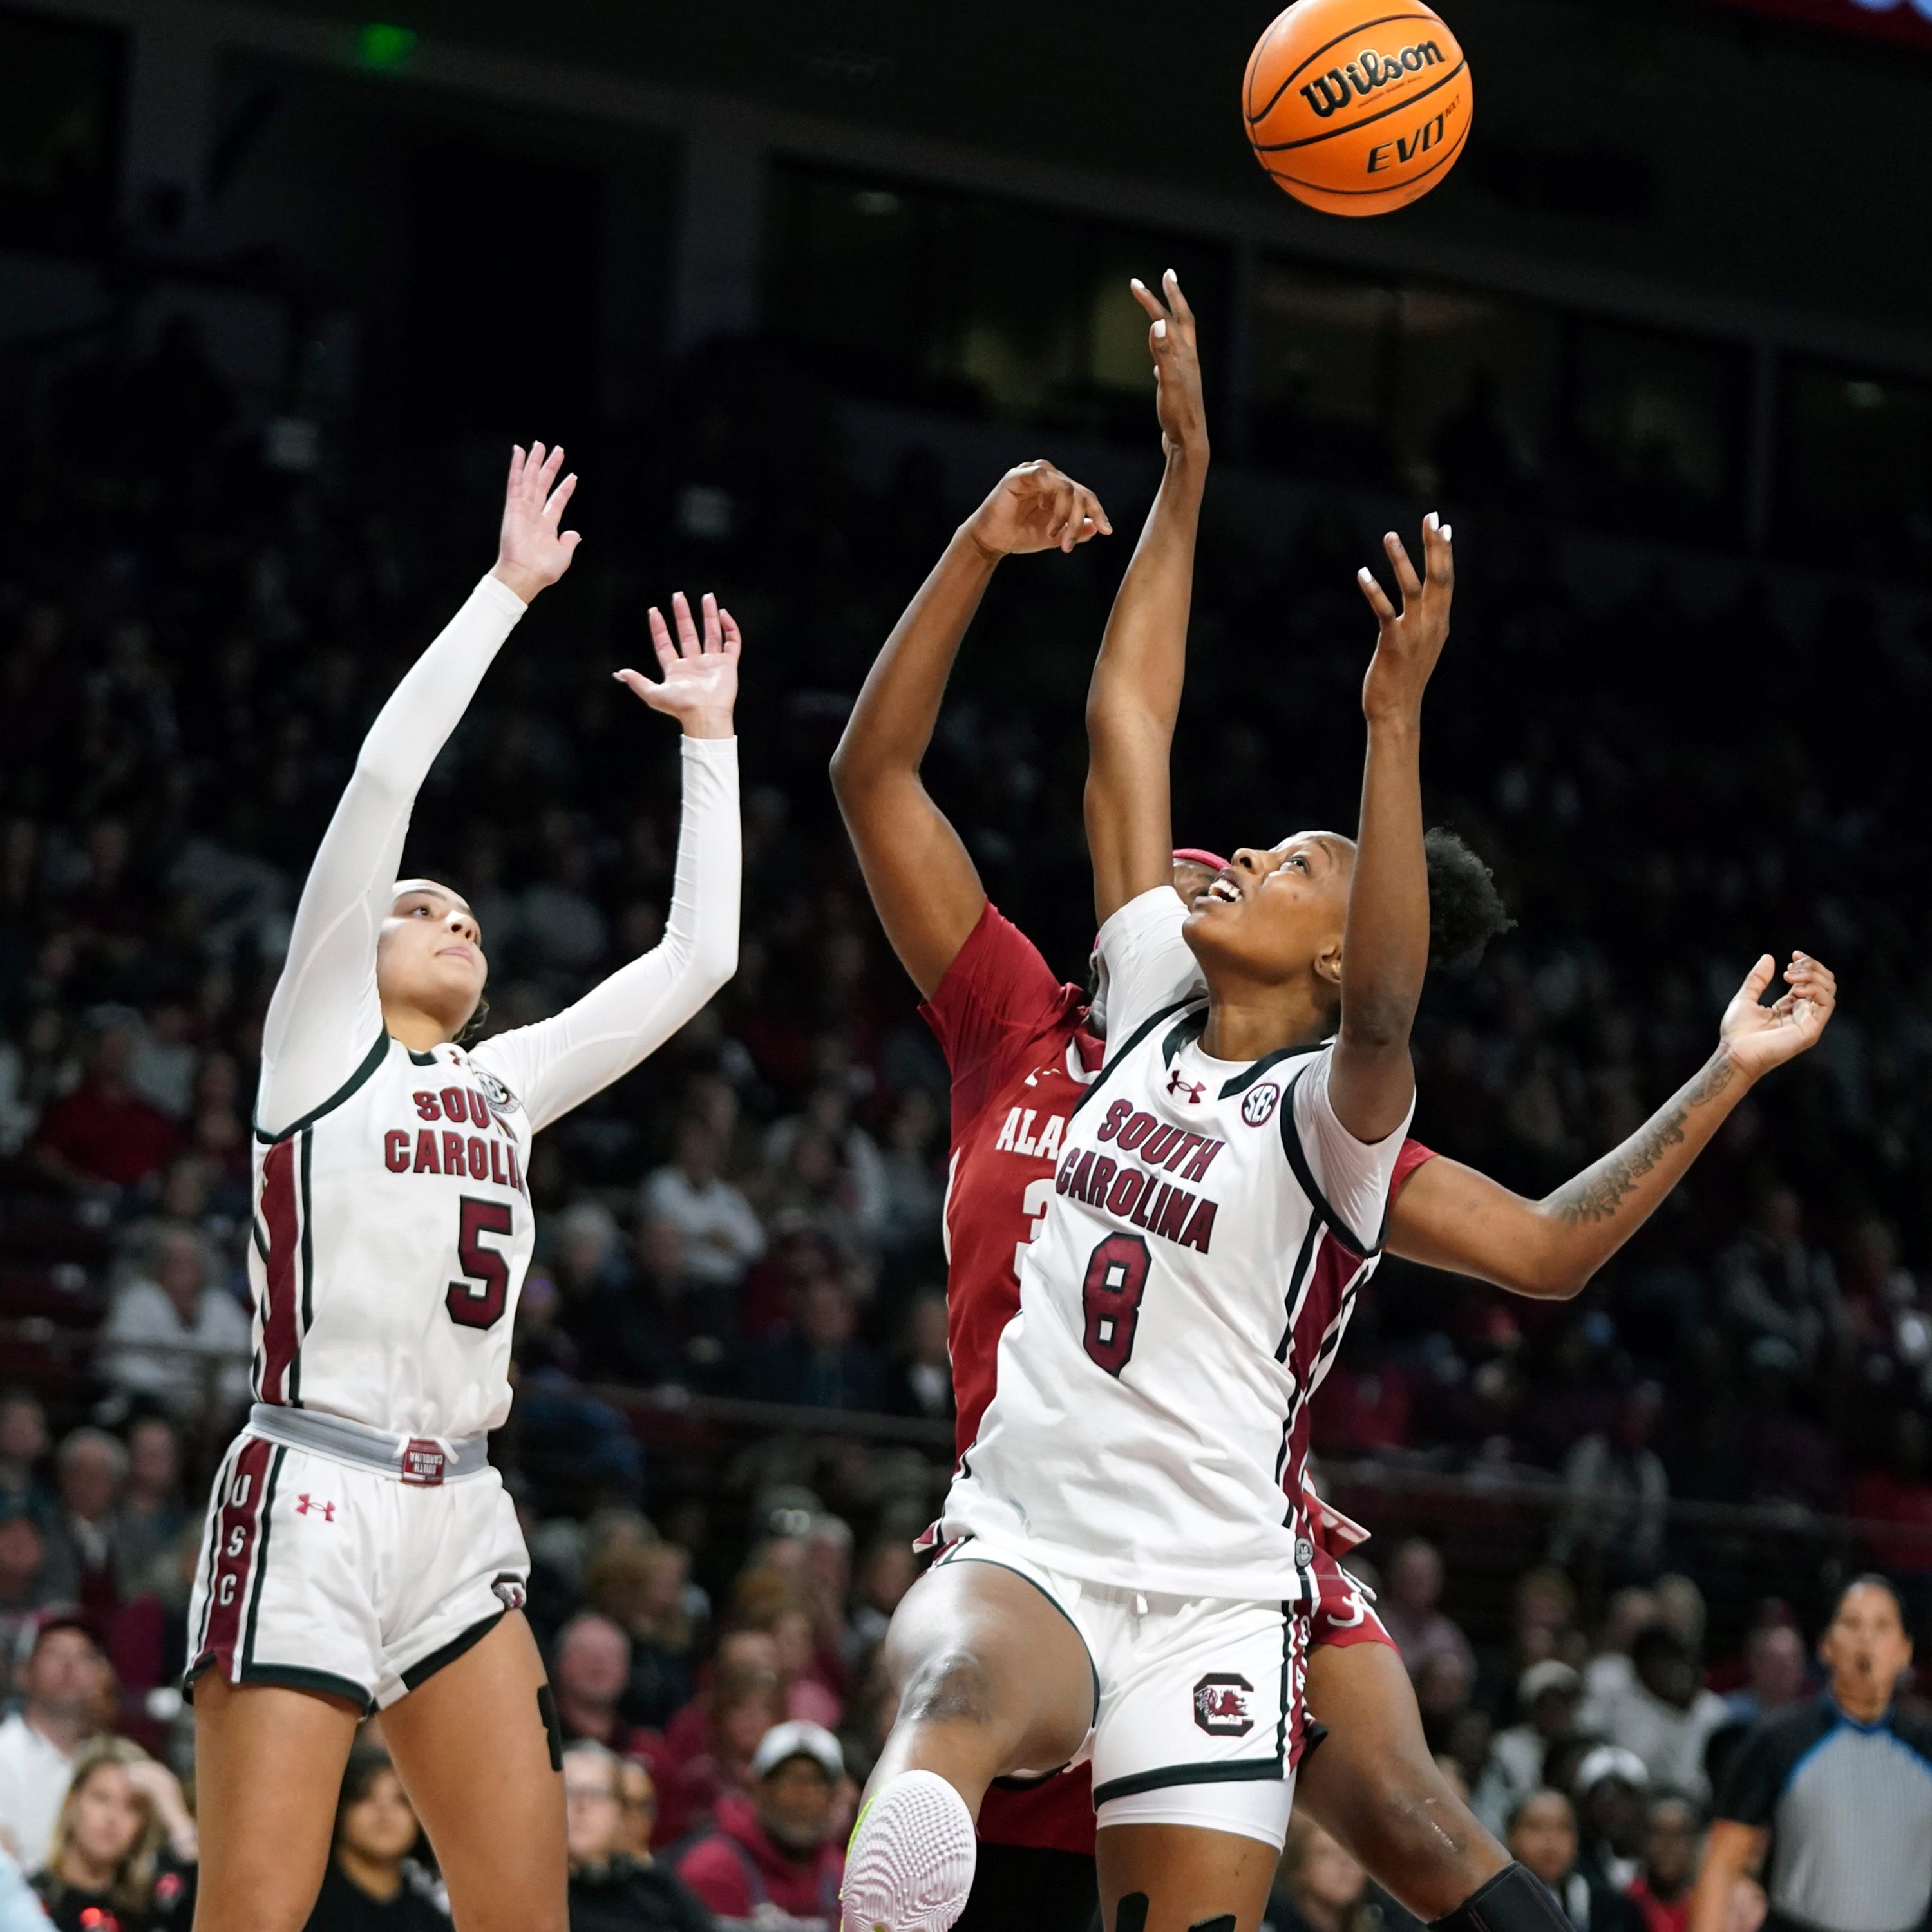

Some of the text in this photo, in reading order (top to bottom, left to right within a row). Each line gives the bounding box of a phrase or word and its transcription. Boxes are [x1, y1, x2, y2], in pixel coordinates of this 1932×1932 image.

[1300, 40, 1446, 117] Wilson
[1367, 112, 1445, 173] EVO
[413, 1086, 515, 1140] SOU
[996, 1106, 1066, 1160] ALA
[1243, 1084, 1278, 1124] SEC
[384, 1128, 529, 1200] CAROLI
[1097, 1098, 1225, 1183] SOUTH
[1056, 1148, 1218, 1255] CAROLINA
[445, 1195, 513, 1331] 5
[1082, 1231, 1152, 1378] 8
[410, 1451, 443, 1465] CAROLINA
